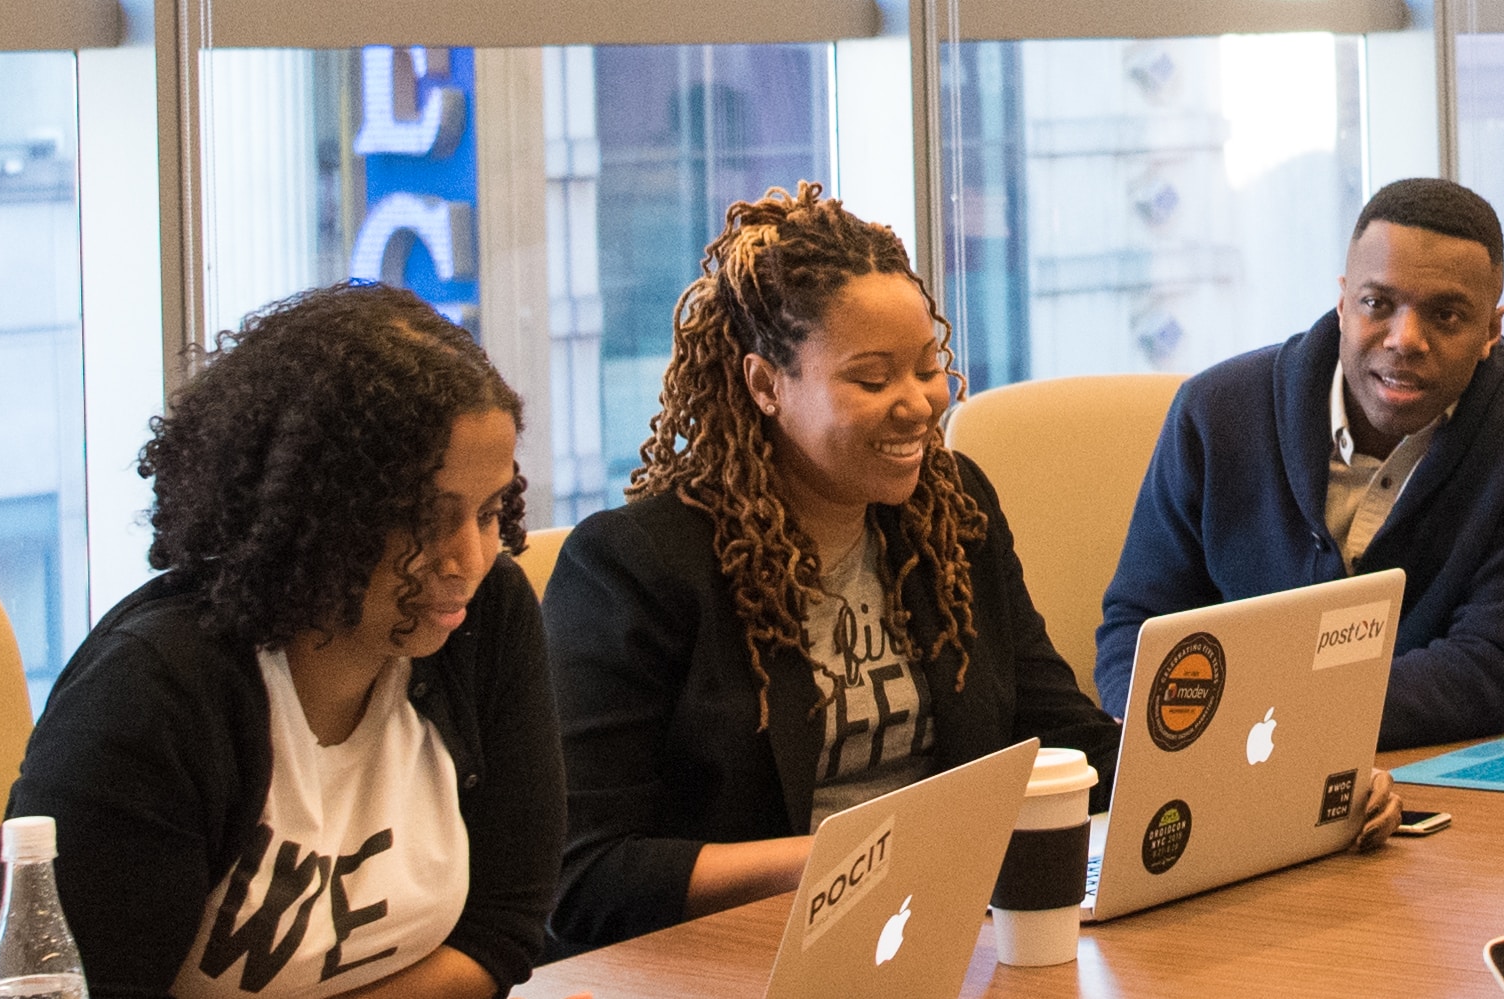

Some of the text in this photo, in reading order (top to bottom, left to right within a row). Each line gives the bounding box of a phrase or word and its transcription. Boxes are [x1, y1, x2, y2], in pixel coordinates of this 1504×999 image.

[1178, 685, 1209, 699] modev
[1340, 792, 1350, 802] IN
[1327, 805, 1348, 818] TECH
[809, 829, 892, 926] POCIT
[198, 822, 399, 993] WE
